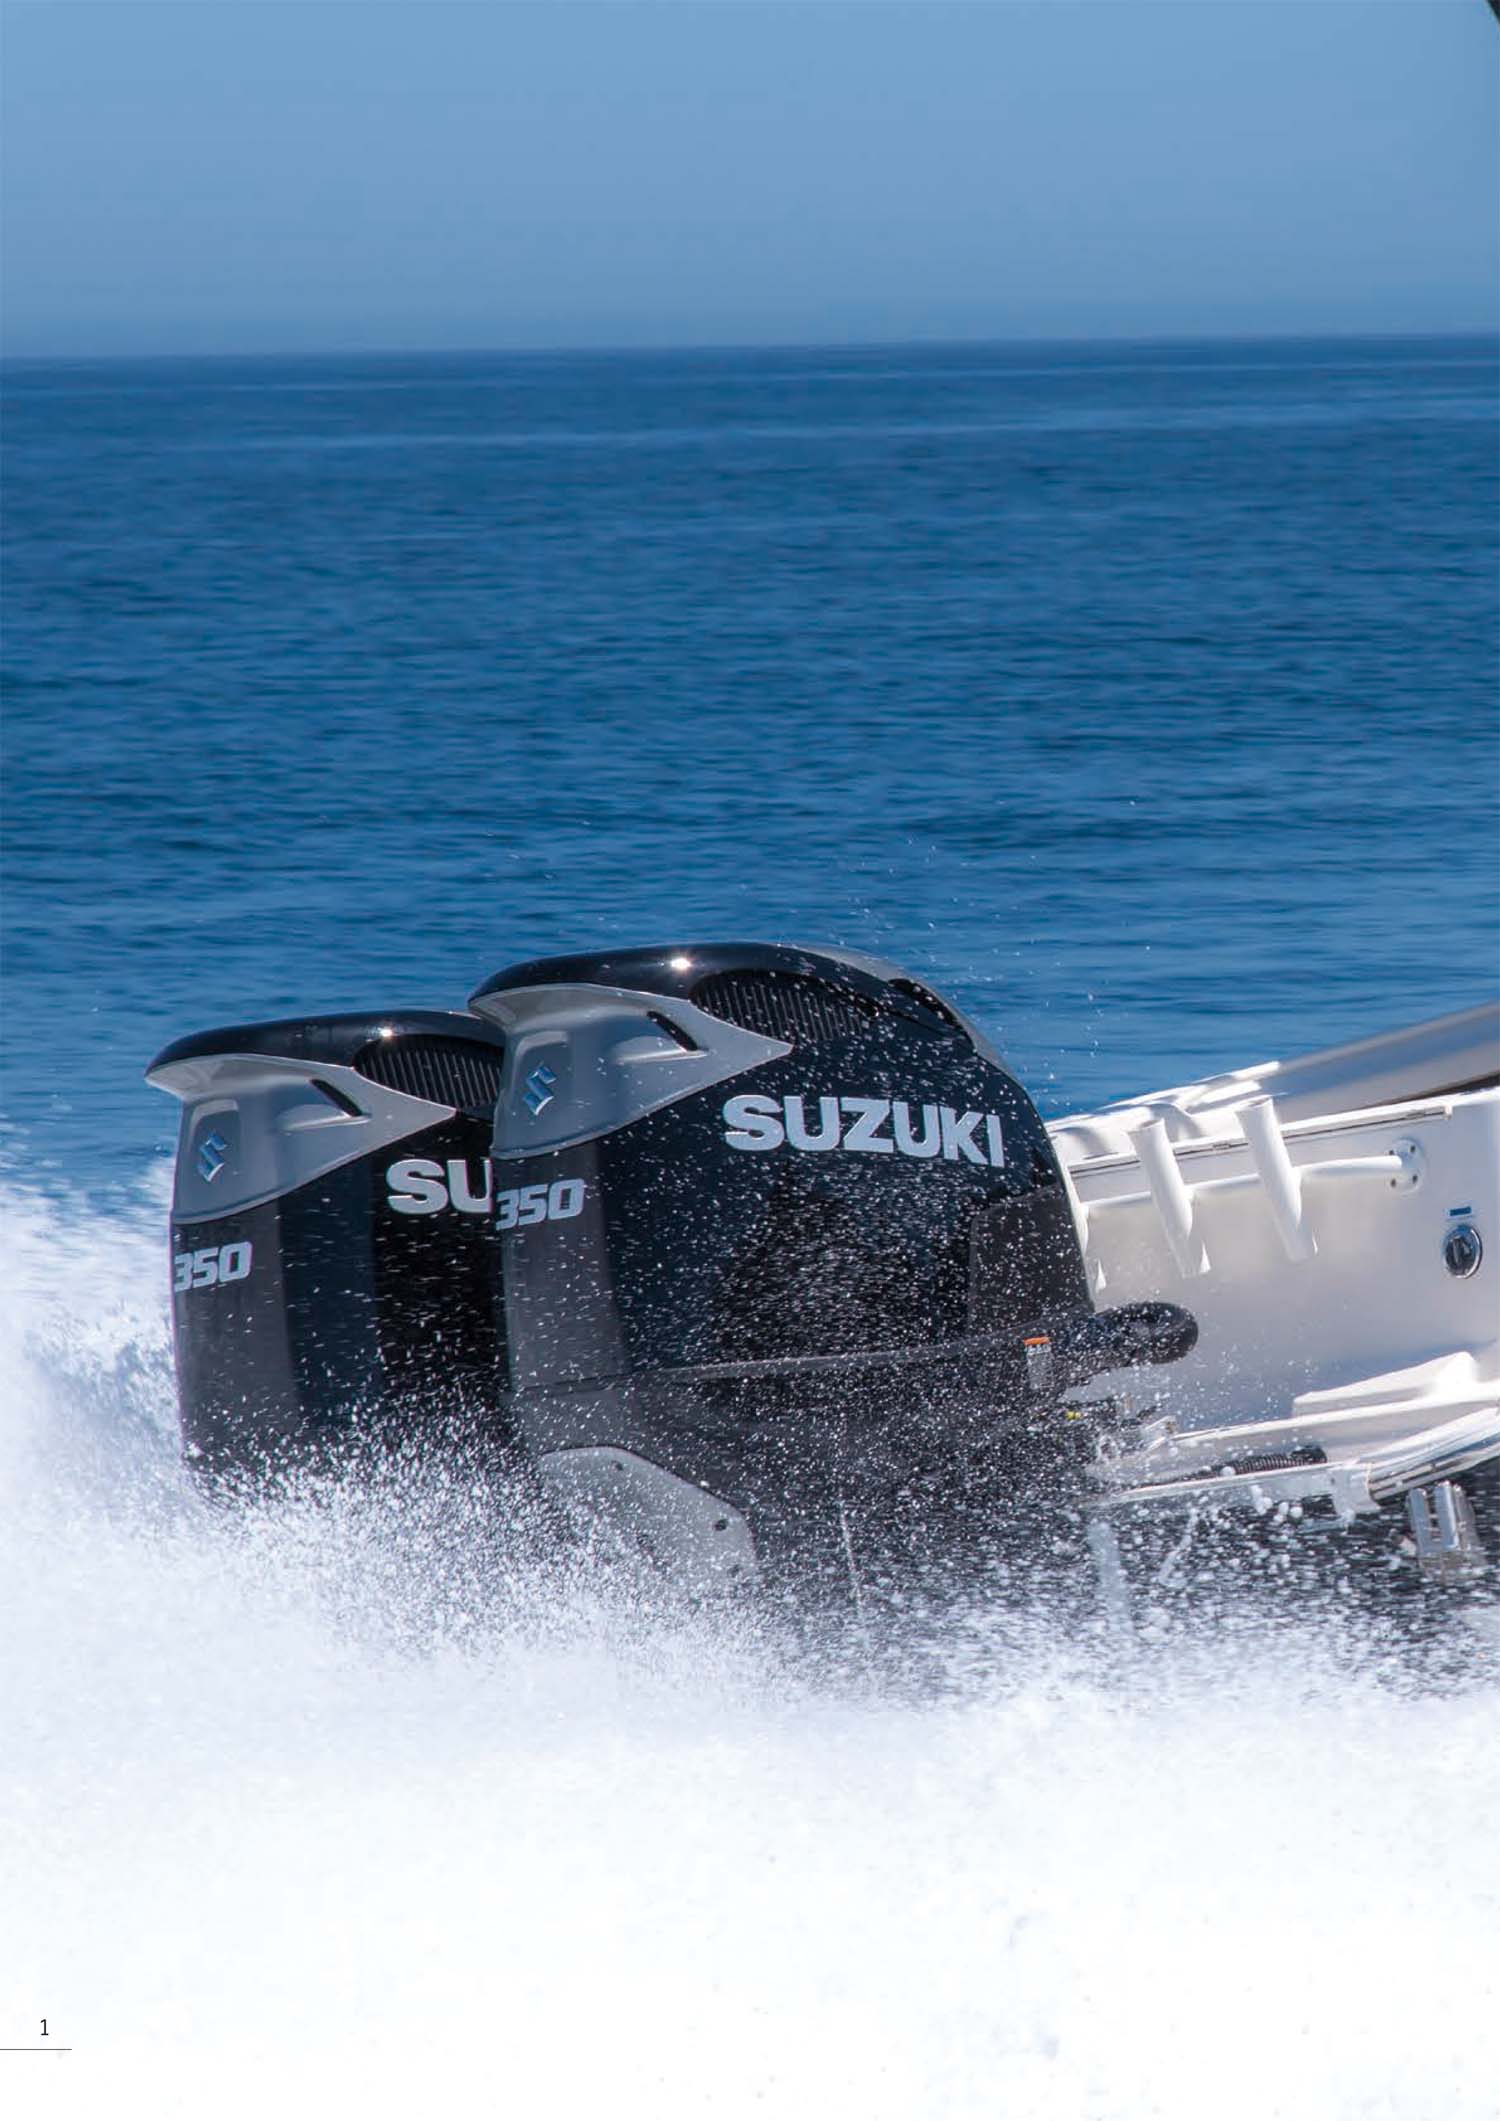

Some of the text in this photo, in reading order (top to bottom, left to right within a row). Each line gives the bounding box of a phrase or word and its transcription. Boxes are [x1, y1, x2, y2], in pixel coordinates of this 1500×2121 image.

[722, 1094, 1005, 1168] SUZUKI
[496, 1178, 585, 1231] 350
[173, 1241, 253, 1293] 350
